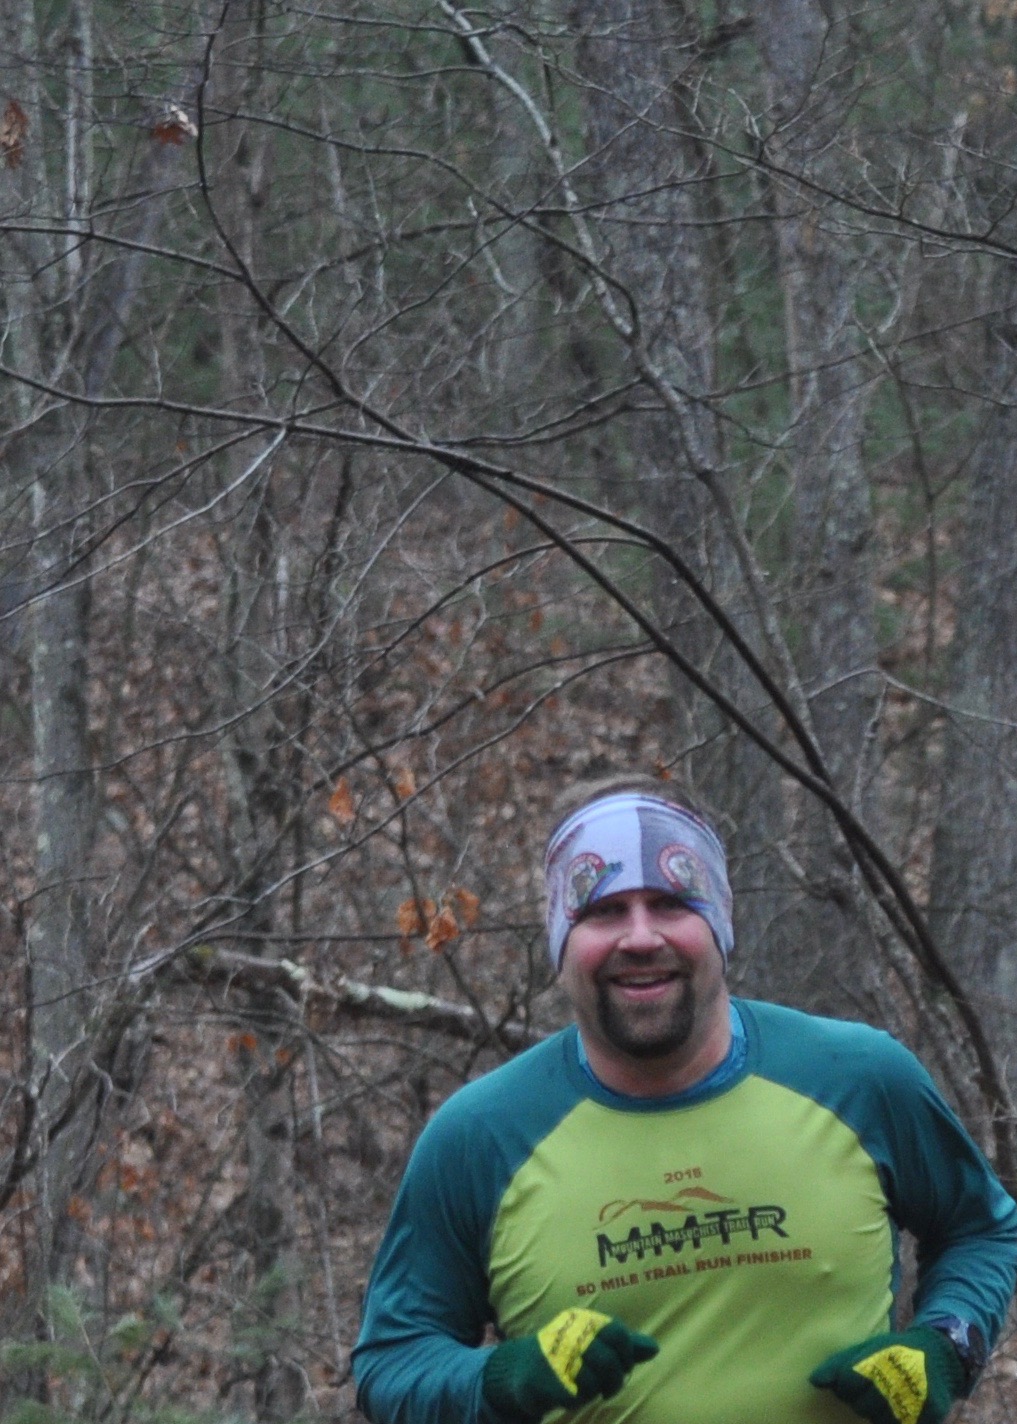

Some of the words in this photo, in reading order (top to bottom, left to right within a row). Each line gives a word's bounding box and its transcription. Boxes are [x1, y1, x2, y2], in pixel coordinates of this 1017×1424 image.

[597, 1205, 789, 1267] MMTR
[601, 1273, 639, 1291] MILE
[643, 1263, 690, 1283] TRAIL
[695, 1256, 732, 1273] RUN
[737, 1248, 812, 1266] FINISHER
